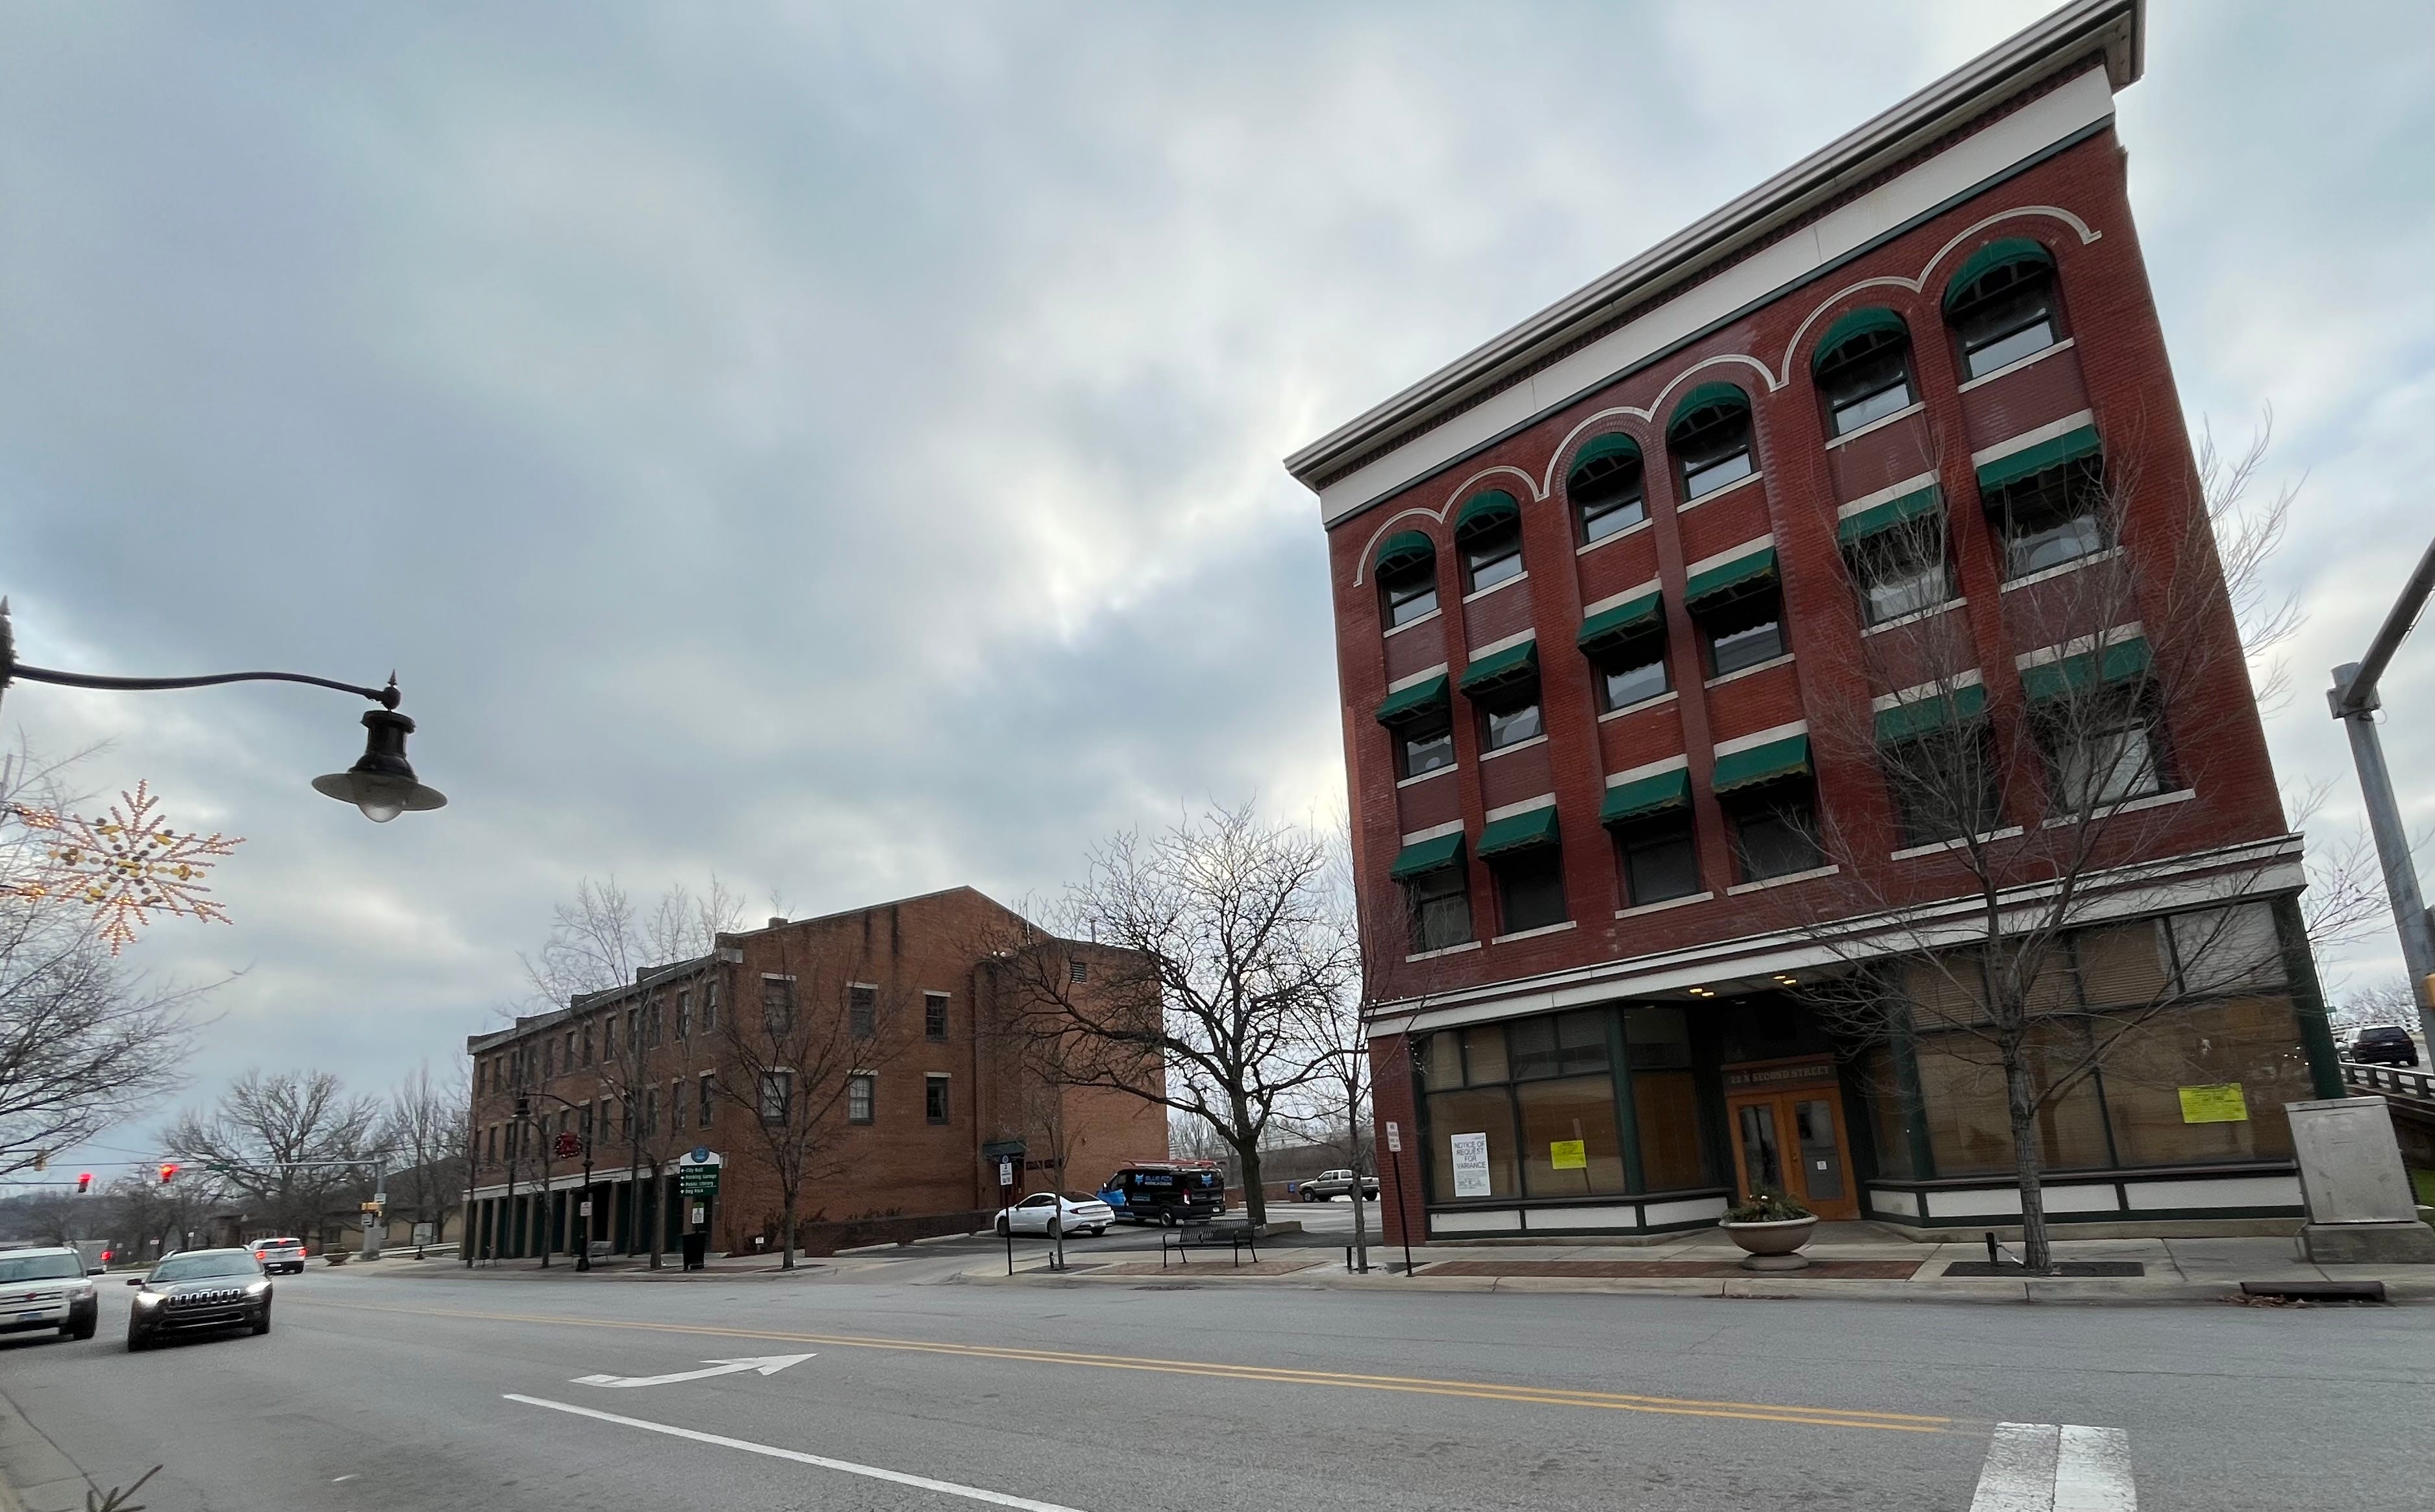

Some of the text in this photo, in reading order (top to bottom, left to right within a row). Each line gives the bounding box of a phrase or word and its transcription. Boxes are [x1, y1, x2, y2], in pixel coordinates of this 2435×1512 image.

[1730, 1075, 1742, 1084] 22
[1752, 1071, 1790, 1082] SECOND
[1792, 1065, 1829, 1078] STREET
